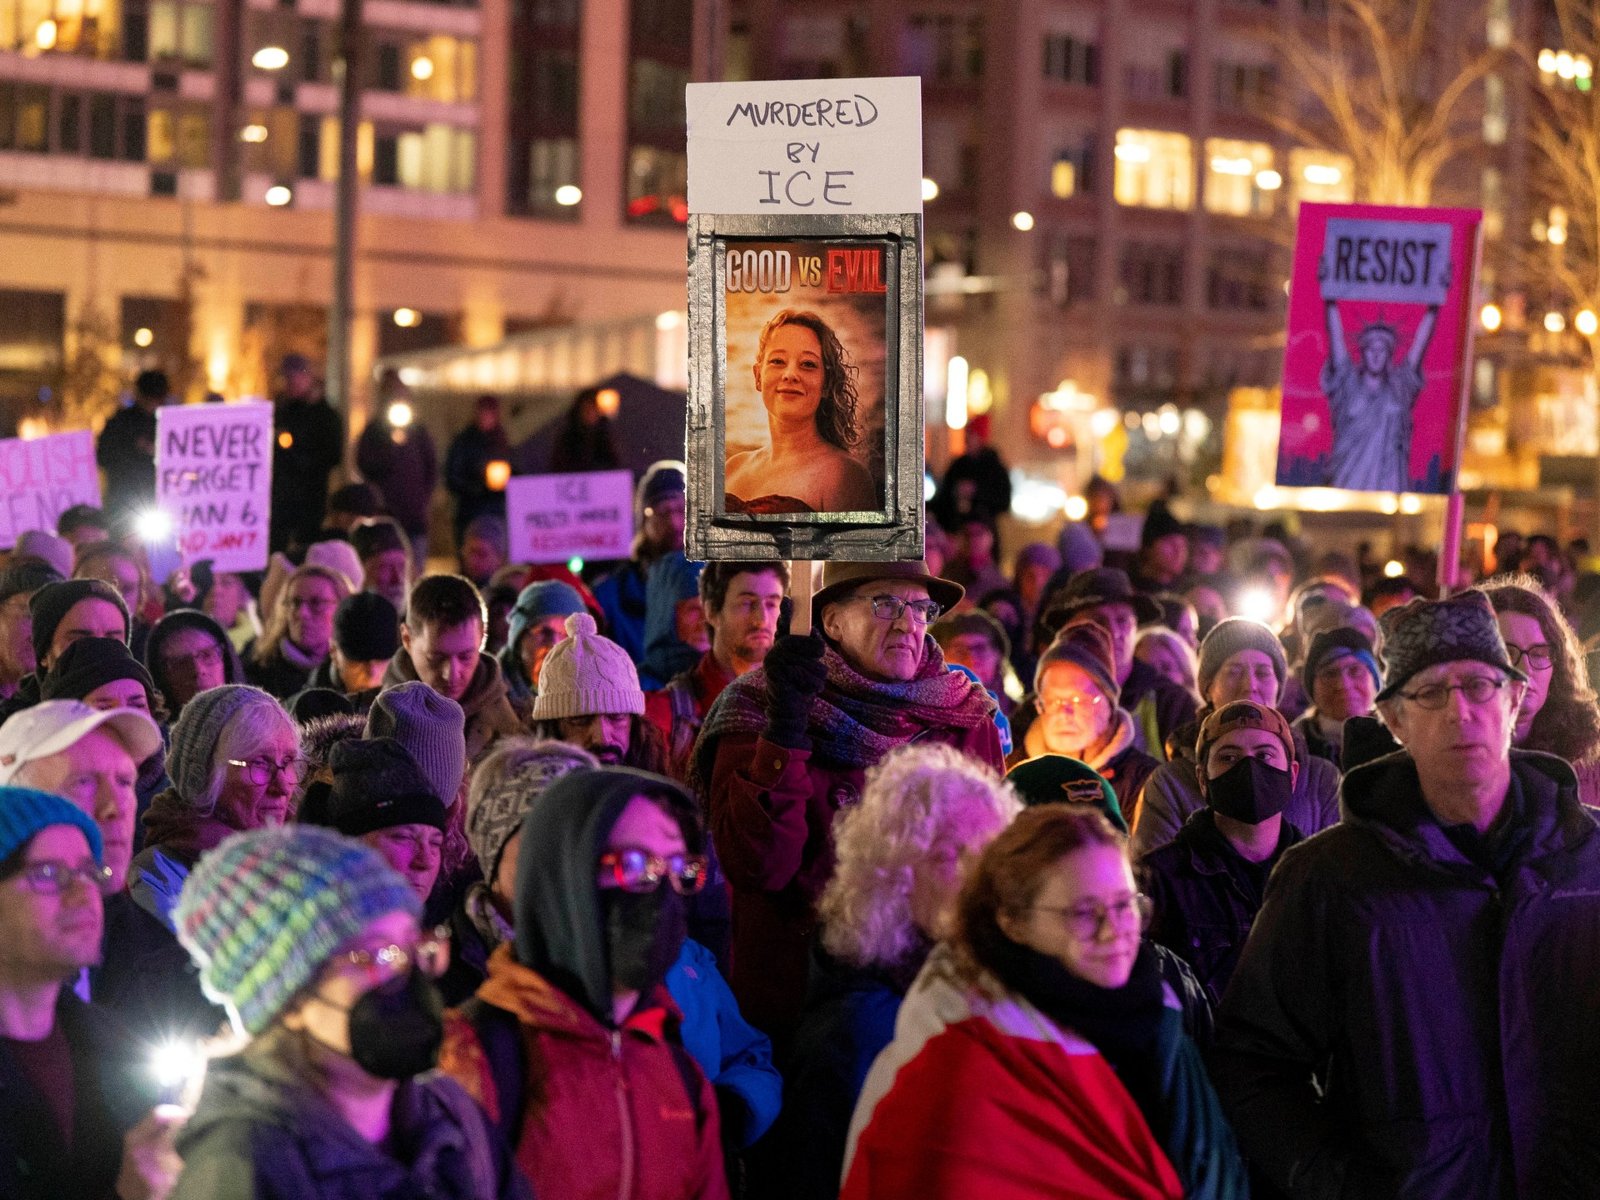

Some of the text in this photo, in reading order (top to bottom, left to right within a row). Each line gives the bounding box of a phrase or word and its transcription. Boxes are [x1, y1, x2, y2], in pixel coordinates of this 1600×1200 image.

[727, 94, 878, 128] MURDERED
[786, 142, 820, 163] BY
[758, 170, 855, 207] ICE
[726, 249, 888, 294] GOOD VS EVIL
[1335, 237, 1438, 286] RESIST
[167, 422, 262, 460] NEVER
[162, 462, 260, 497] FORGET
[241, 501, 258, 527] 6
